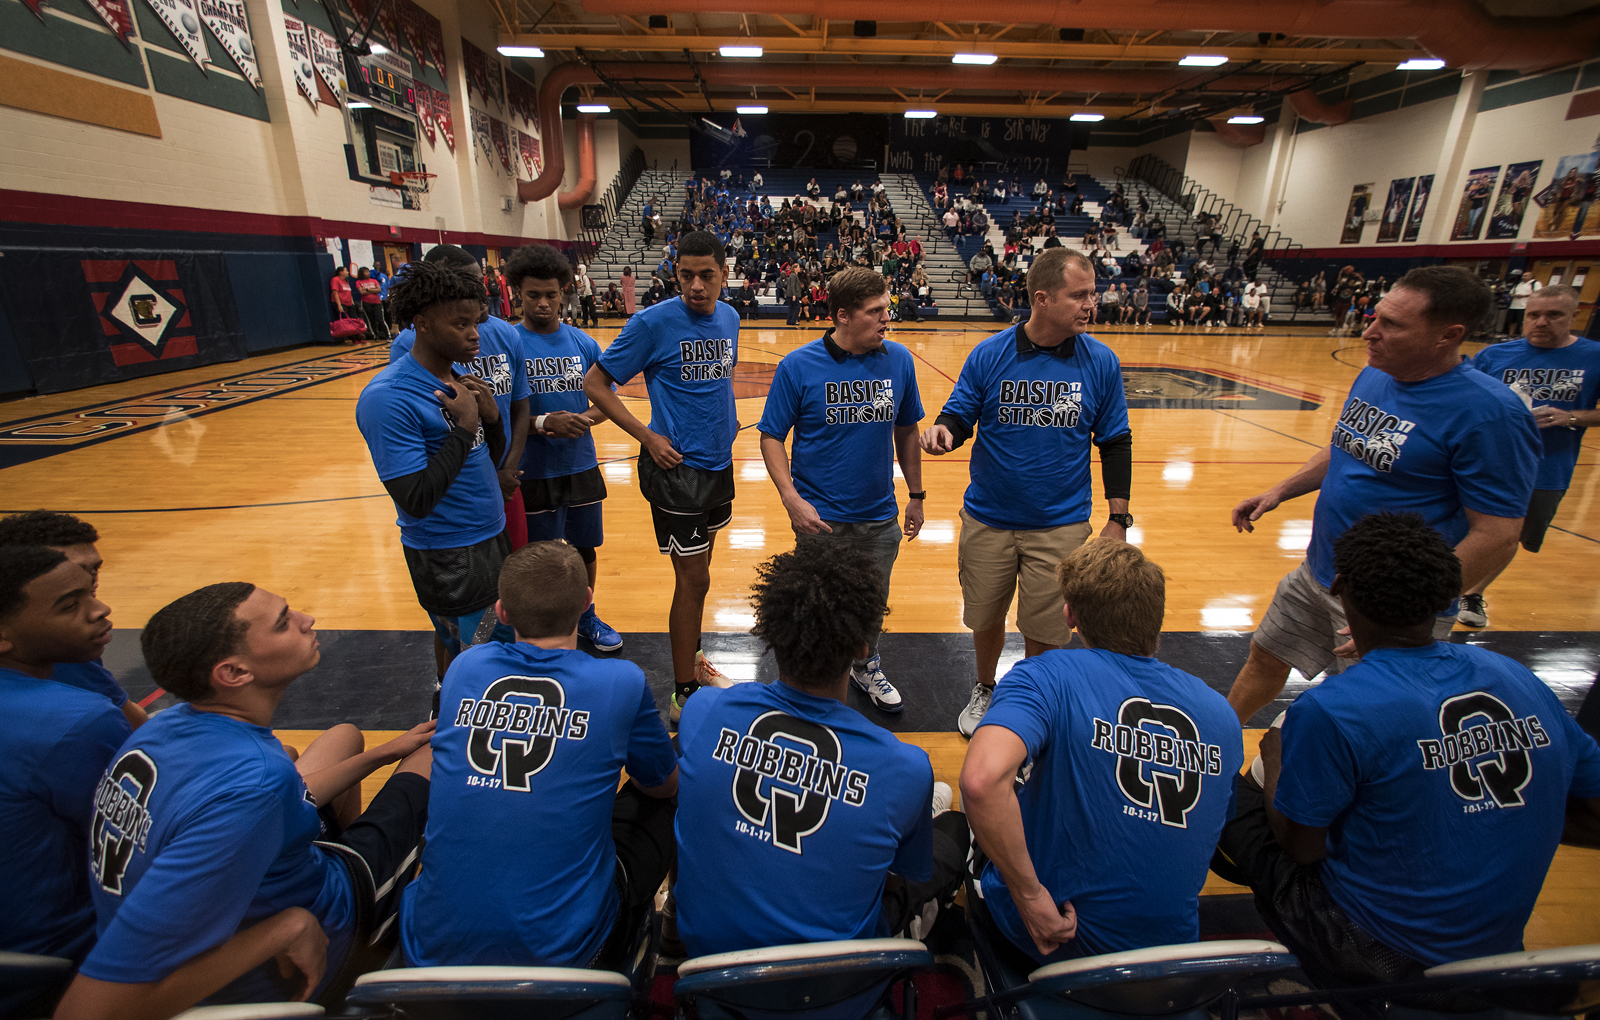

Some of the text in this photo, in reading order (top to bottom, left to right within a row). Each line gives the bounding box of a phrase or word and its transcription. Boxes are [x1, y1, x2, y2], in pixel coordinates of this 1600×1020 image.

[200, 1, 248, 34] CHAMPIONS
[203, 0, 245, 19] TATE
[153, 1, 199, 60] OLLEYBALL
[219, 20, 235, 35] 2013
[209, 20, 253, 79] VOLLEYBALL
[680, 338, 728, 363] BASIC
[525, 356, 573, 377] BASIC
[1502, 368, 1572, 386] BASIC
[825, 379, 884, 405] BASIC
[999, 379, 1070, 405] BASIC
[1339, 396, 1401, 438] BASIC
[454, 698, 590, 740] ROBBINS
[1091, 717, 1222, 776] ROBBINS
[1416, 715, 1551, 770] ROBBINS
[712, 727, 869, 807] ROBBINS
[466, 775, 502, 789] 10-1-17
[1122, 805, 1158, 822] 10-1-17
[735, 820, 771, 842] 10-1-17
